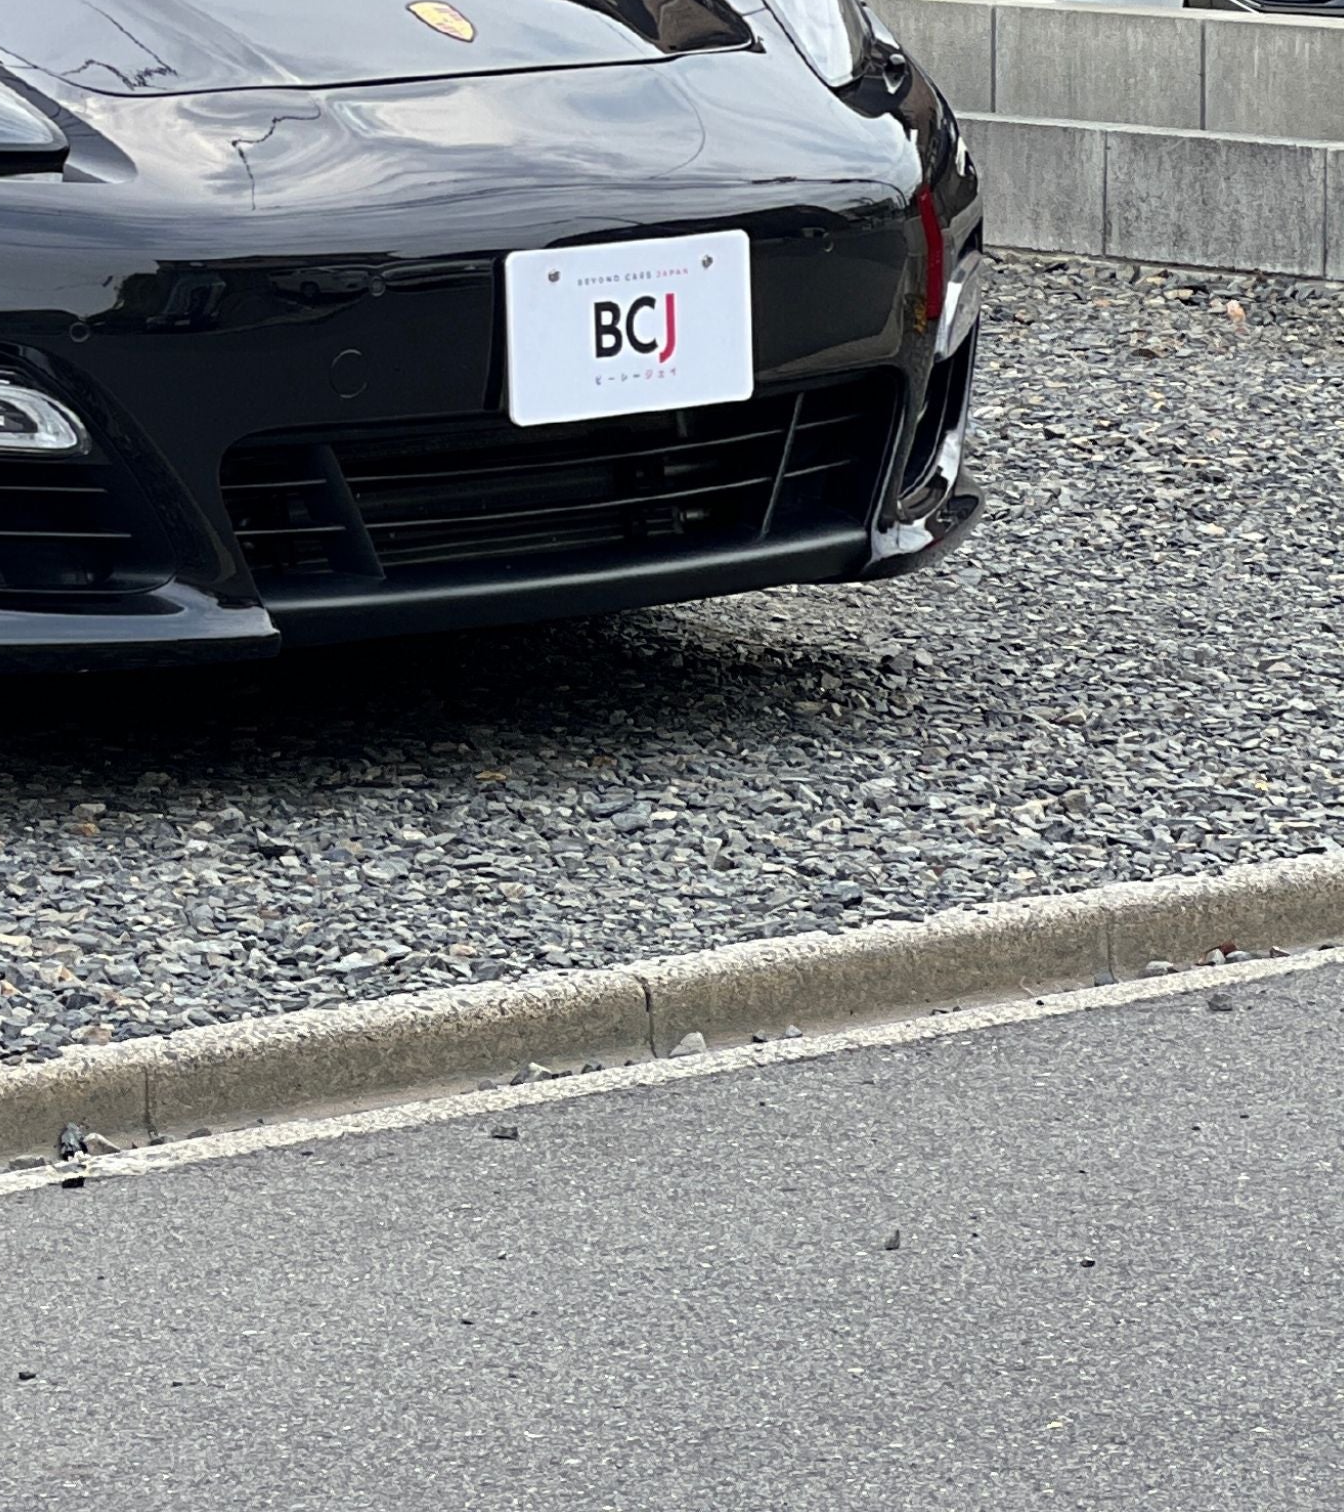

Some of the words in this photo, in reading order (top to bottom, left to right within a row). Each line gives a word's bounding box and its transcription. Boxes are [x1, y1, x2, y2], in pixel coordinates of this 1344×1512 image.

[577, 274, 620, 286] BEYOND
[624, 271, 652, 281] CARS
[656, 268, 689, 278] JAPAN
[594, 294, 676, 363] BCJ
